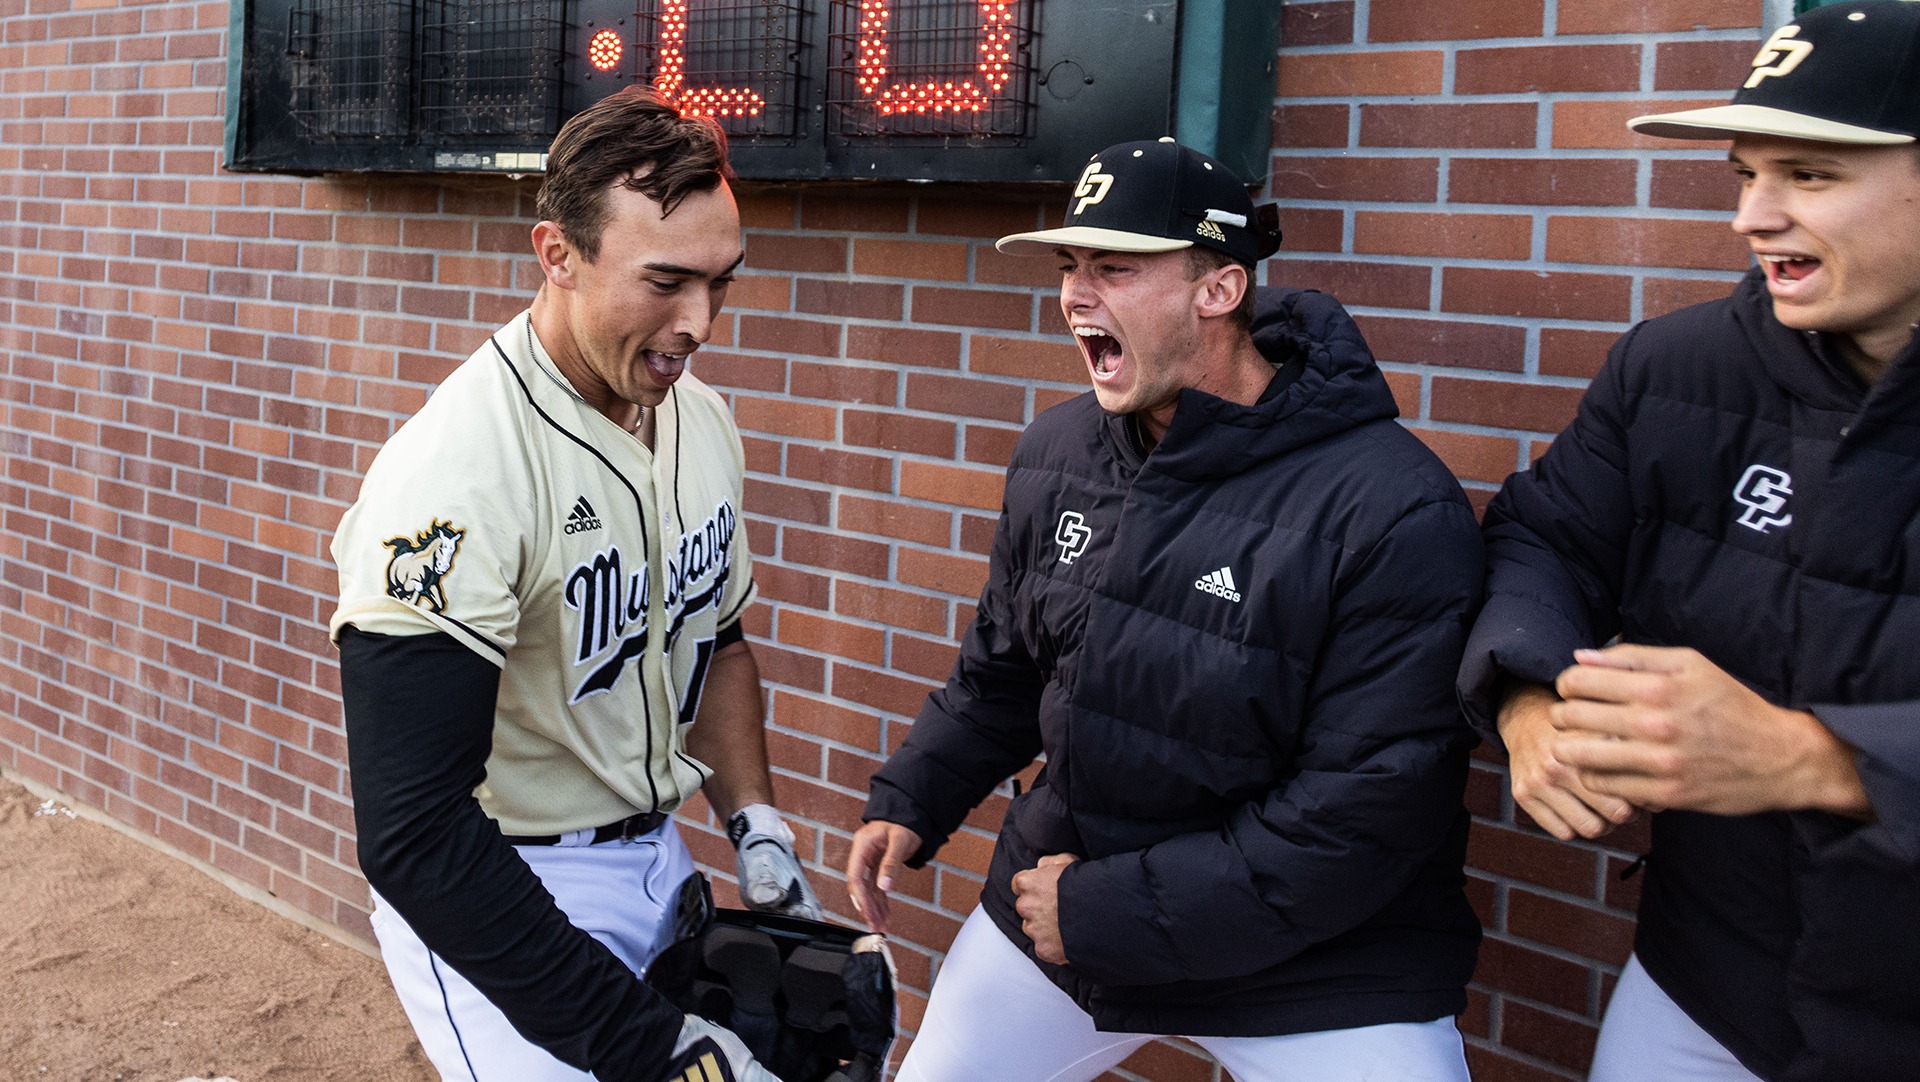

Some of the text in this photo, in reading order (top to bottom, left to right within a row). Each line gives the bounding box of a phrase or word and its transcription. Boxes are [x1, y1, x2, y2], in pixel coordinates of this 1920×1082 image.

[1196, 227, 1226, 242] adidas
[564, 518, 602, 535] adidas
[1194, 579, 1241, 603] adidas
